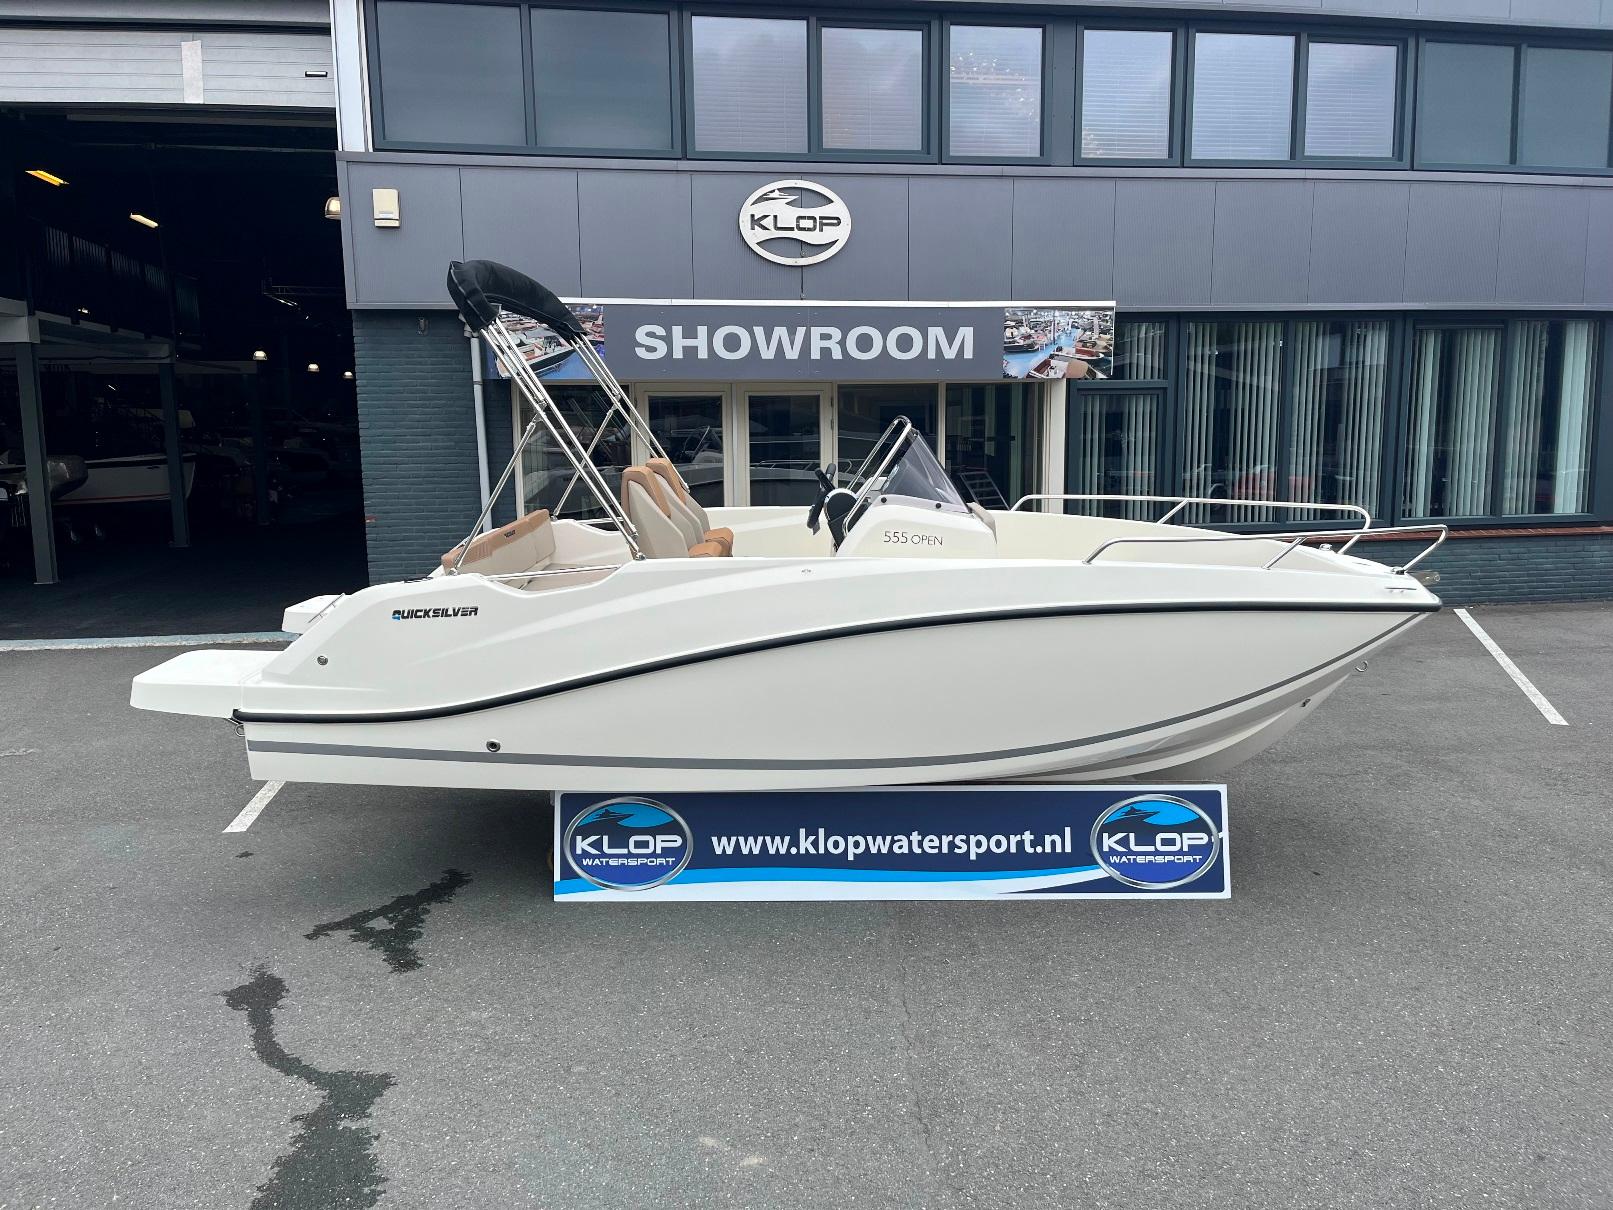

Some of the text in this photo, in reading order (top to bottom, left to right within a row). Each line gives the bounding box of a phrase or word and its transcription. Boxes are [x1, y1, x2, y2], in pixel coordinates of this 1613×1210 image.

[750, 214, 841, 232] KLOP
[634, 325, 974, 360] SHOWROOM
[883, 531, 943, 546] 555 OPEN
[392, 606, 479, 621] QUICKSILVER
[575, 835, 683, 855] KLOP
[711, 826, 1072, 861] www.klopwatersport.nl
[1102, 832, 1209, 853] KLOP
[582, 857, 676, 866] WATERSPORT
[1109, 855, 1203, 864] WATERSPORT
